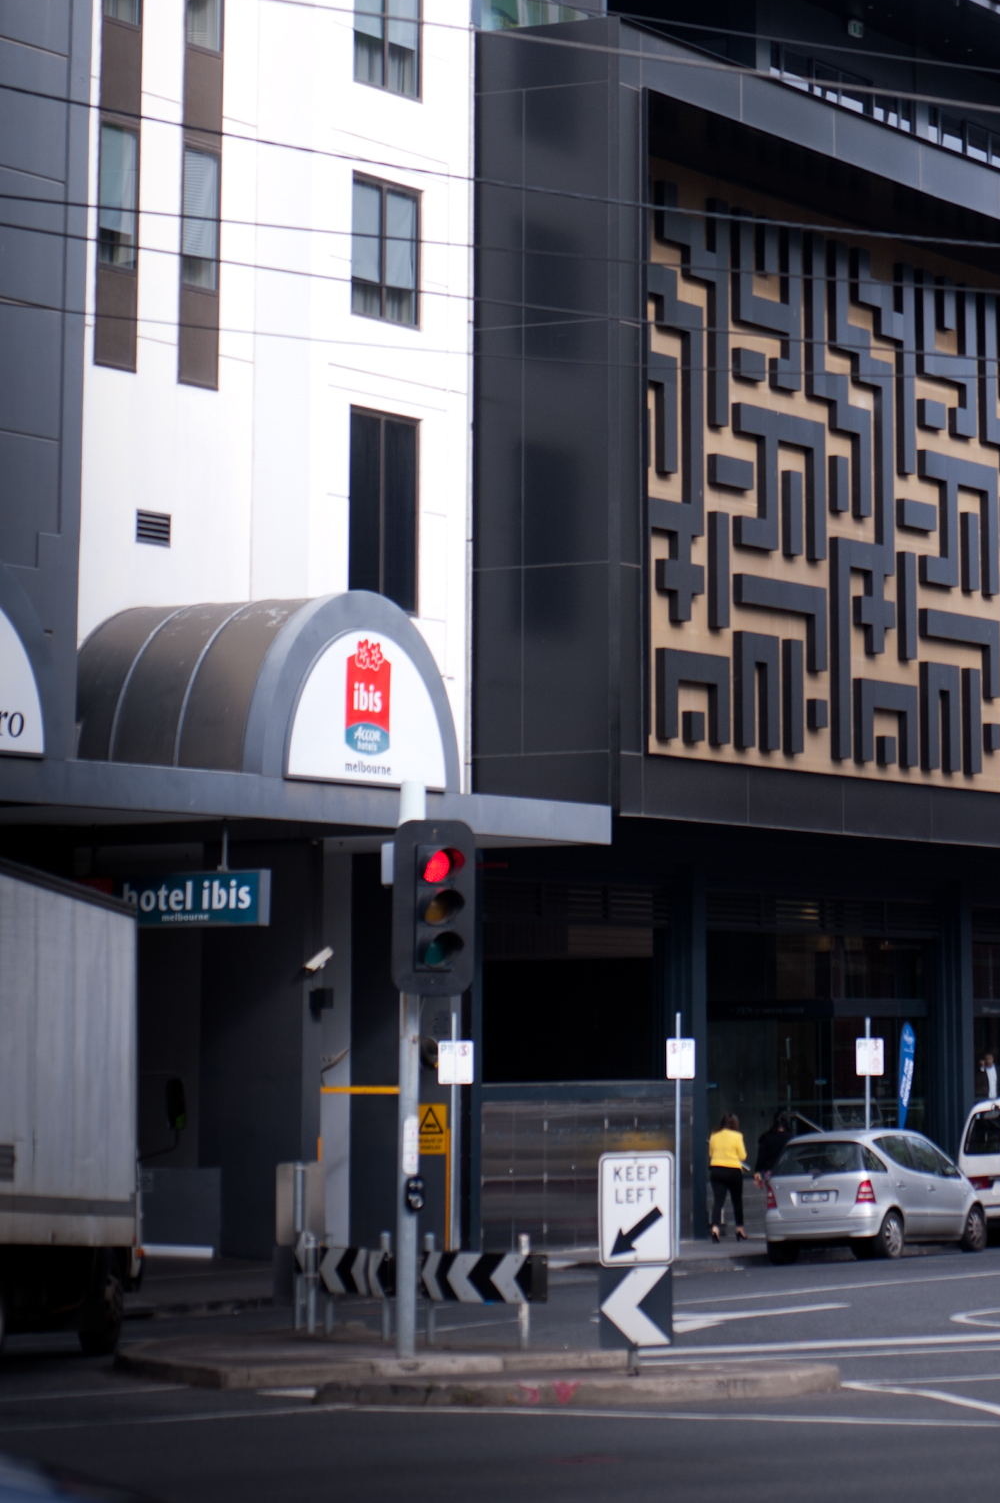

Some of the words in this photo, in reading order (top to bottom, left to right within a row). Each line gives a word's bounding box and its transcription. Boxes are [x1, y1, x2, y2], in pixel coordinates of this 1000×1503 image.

[353, 682, 383, 713] ibis
[357, 741, 378, 752] hotels
[345, 761, 392, 776] melbourne
[122, 879, 193, 912] hotel
[201, 879, 252, 910] ibis
[161, 912, 210, 922] melbourne
[613, 1165, 658, 1182] KEEP
[615, 1187, 656, 1204] LEFT
